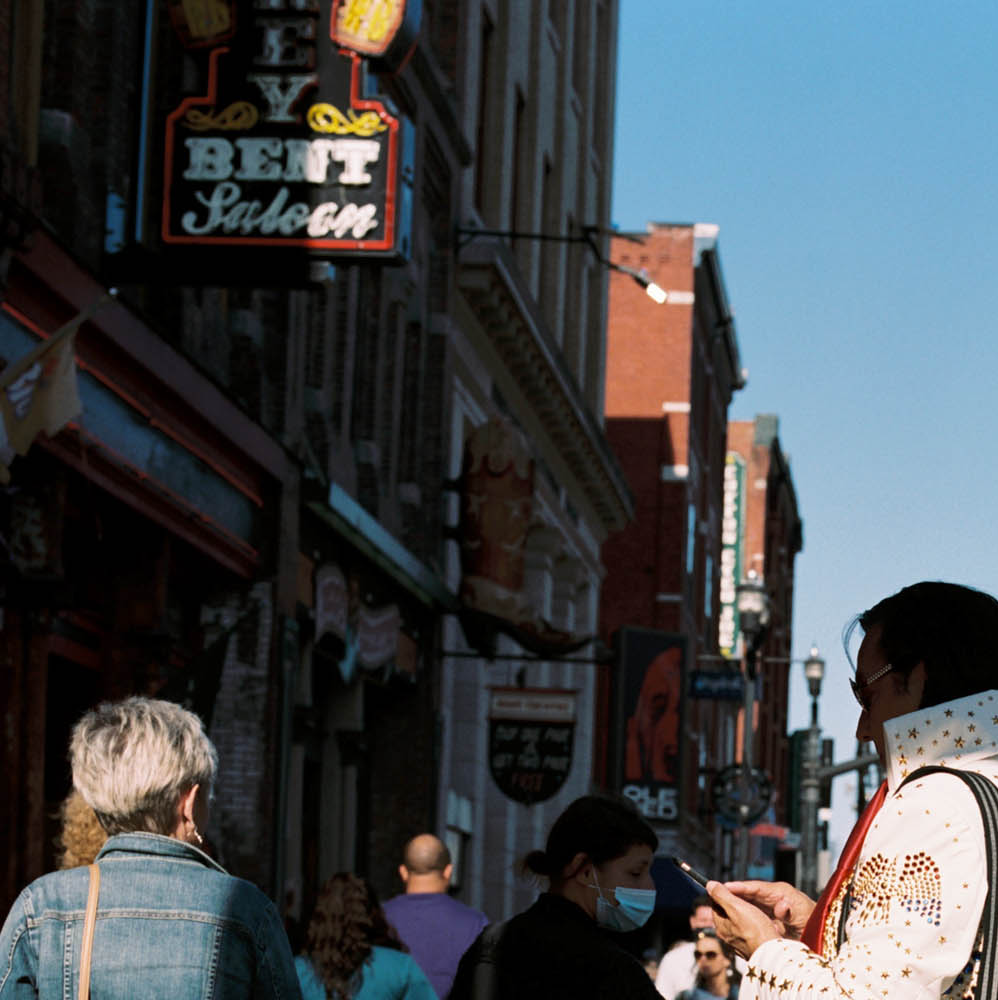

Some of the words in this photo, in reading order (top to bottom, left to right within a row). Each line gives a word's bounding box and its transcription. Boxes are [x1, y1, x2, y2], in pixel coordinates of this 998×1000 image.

[247, 0, 319, 124] EY
[182, 137, 382, 185] BENT
[181, 181, 380, 239] Saloon
